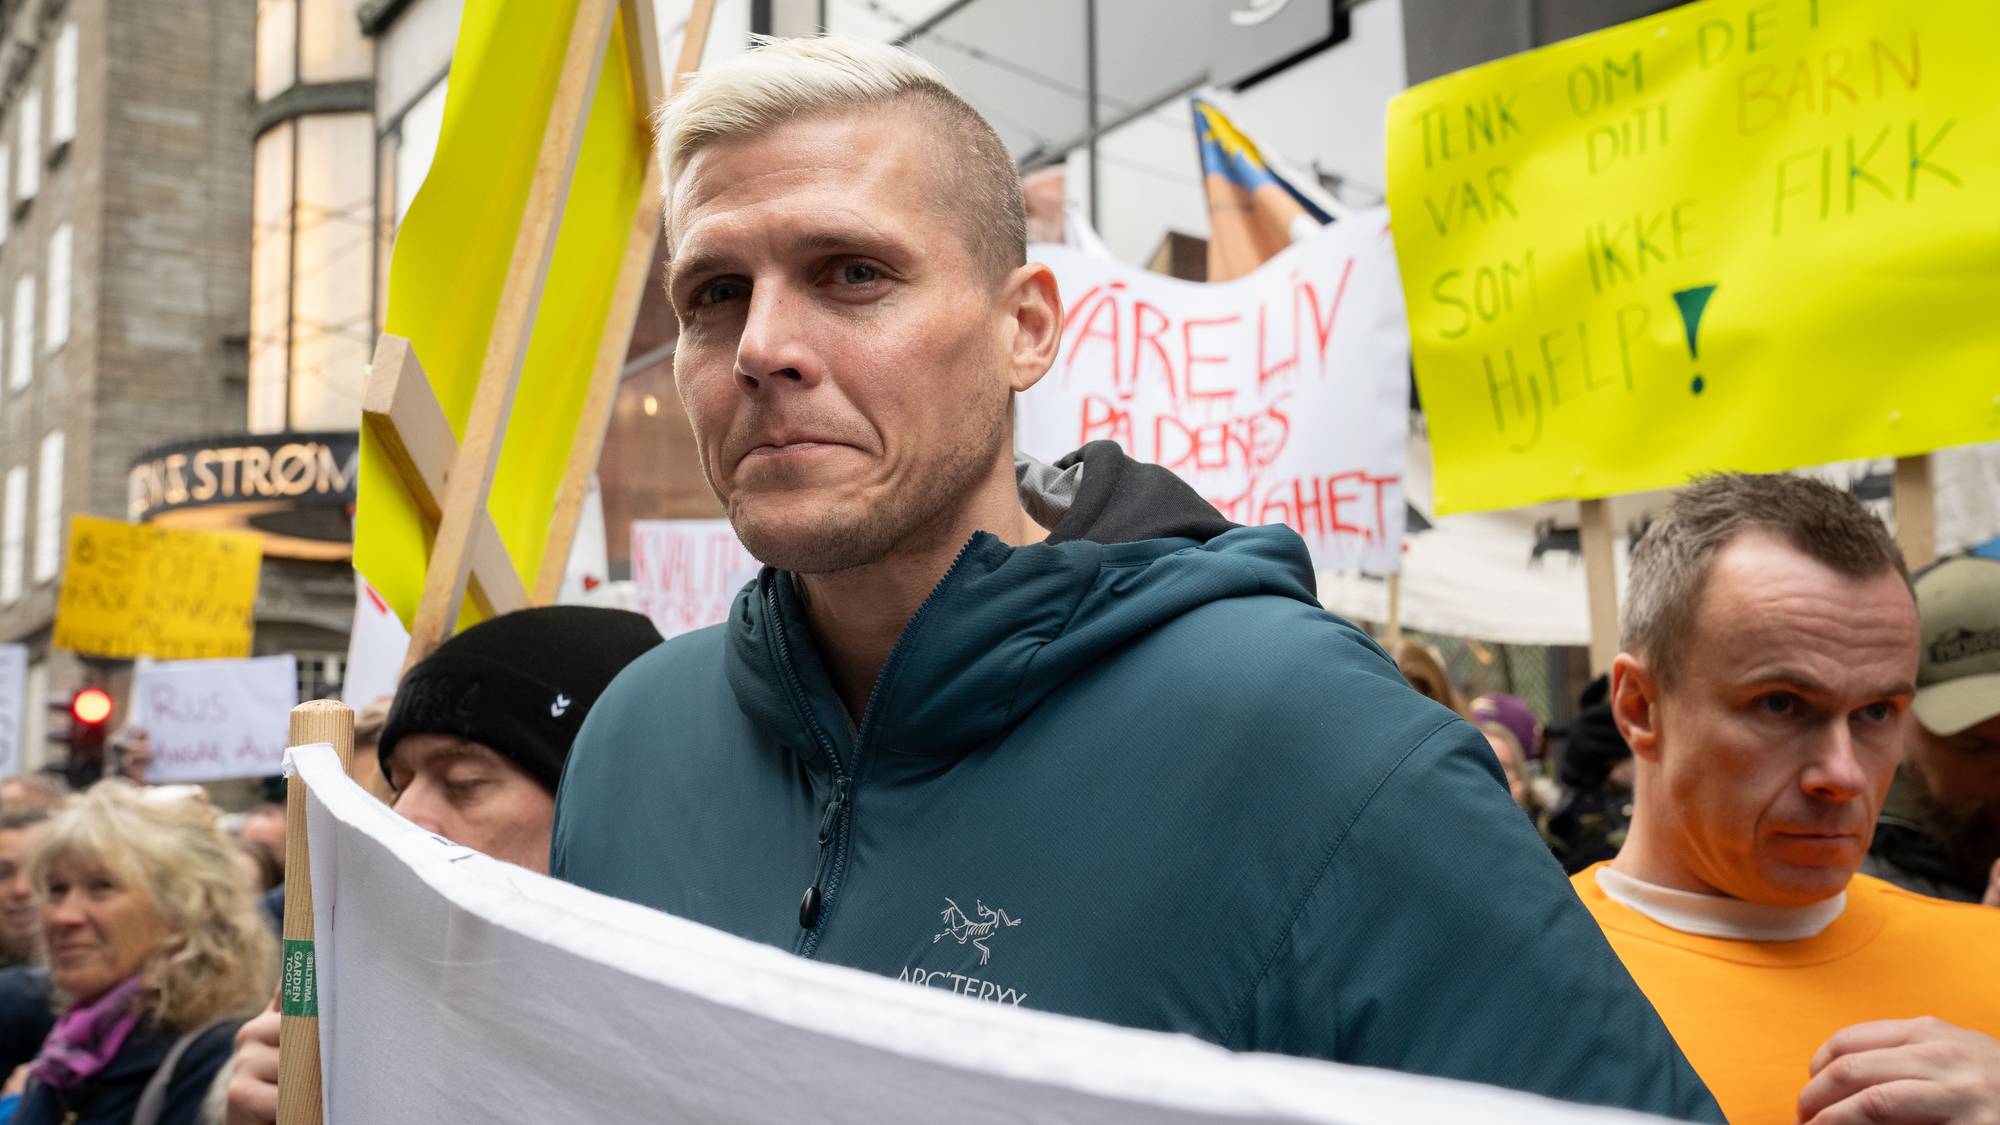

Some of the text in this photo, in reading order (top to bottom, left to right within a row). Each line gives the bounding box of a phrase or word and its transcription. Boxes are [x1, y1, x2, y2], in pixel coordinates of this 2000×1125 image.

[1411, 93, 1521, 172] TENK
[1566, 49, 1644, 120] OM
[1423, 29, 1921, 237] VAR DITT BARN
[1432, 118, 1963, 339] SOM IKKE FIKK
[1257, 256, 1355, 385] LIV
[1079, 392, 1136, 458] PÅ
[291, 951, 303, 1002] GARDEN
